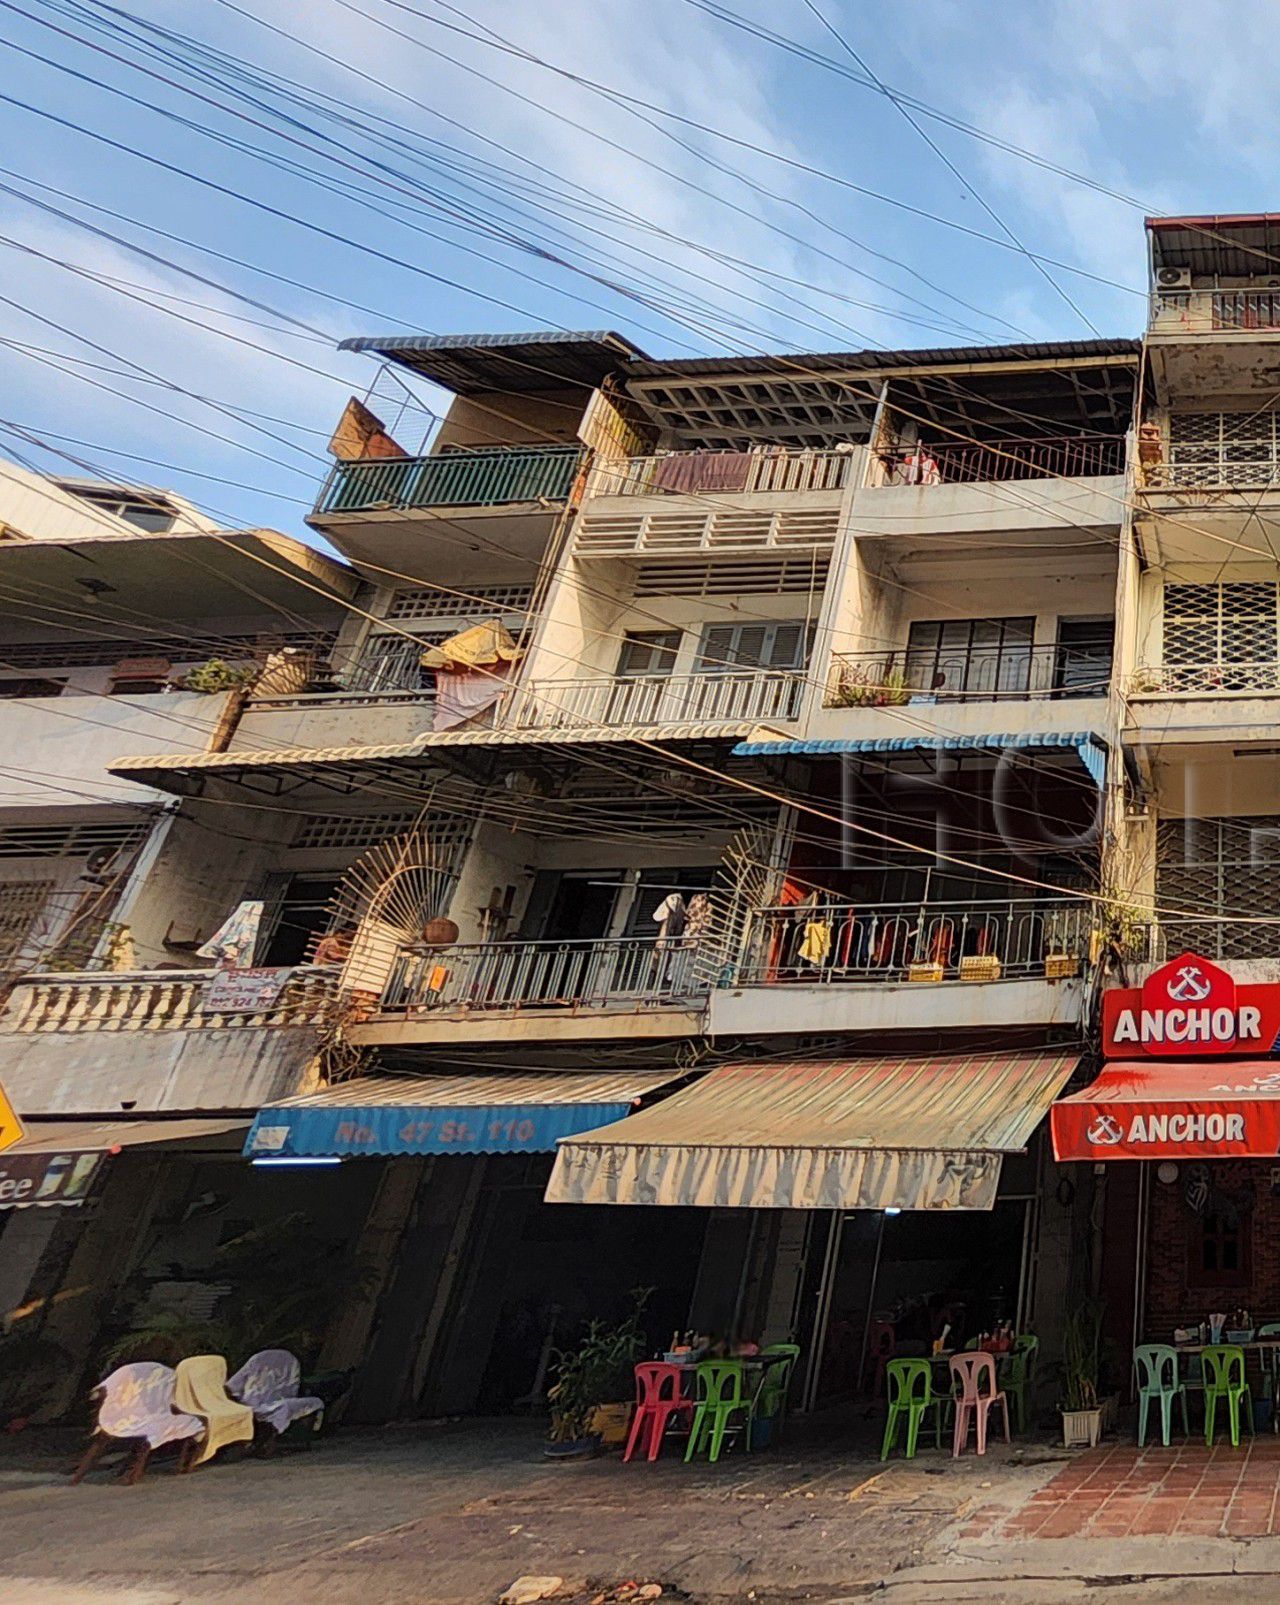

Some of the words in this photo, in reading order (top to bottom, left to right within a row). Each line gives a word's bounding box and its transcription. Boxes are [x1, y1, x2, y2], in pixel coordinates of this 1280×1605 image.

[1113, 1006, 1261, 1043] ANCHOR
[335, 1121, 377, 1144] No.
[488, 1119, 535, 1142] 110
[1127, 1113, 1245, 1143] ANCHOR
